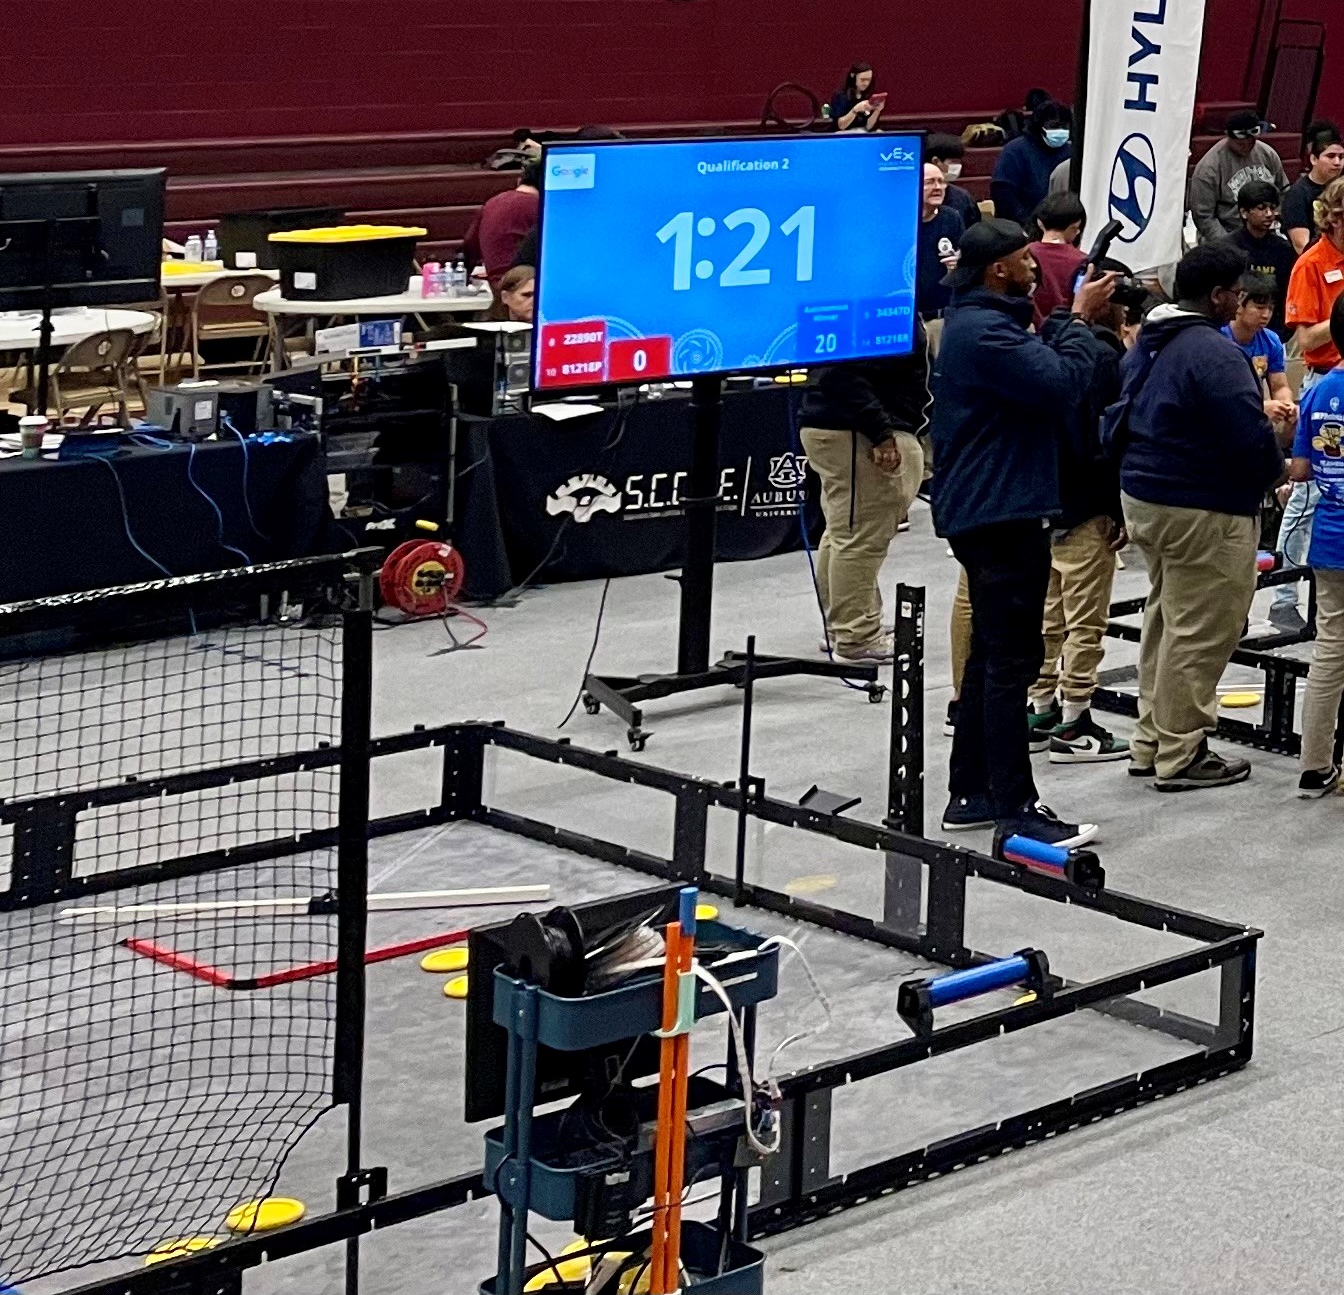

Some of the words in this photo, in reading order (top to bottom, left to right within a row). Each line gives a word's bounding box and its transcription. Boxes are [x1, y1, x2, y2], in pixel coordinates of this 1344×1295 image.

[697, 159, 778, 175] Qualification
[782, 158, 790, 170] 2
[656, 205, 815, 291] 1:21
[815, 333, 837, 354] 20
[633, 350, 647, 371] 0
